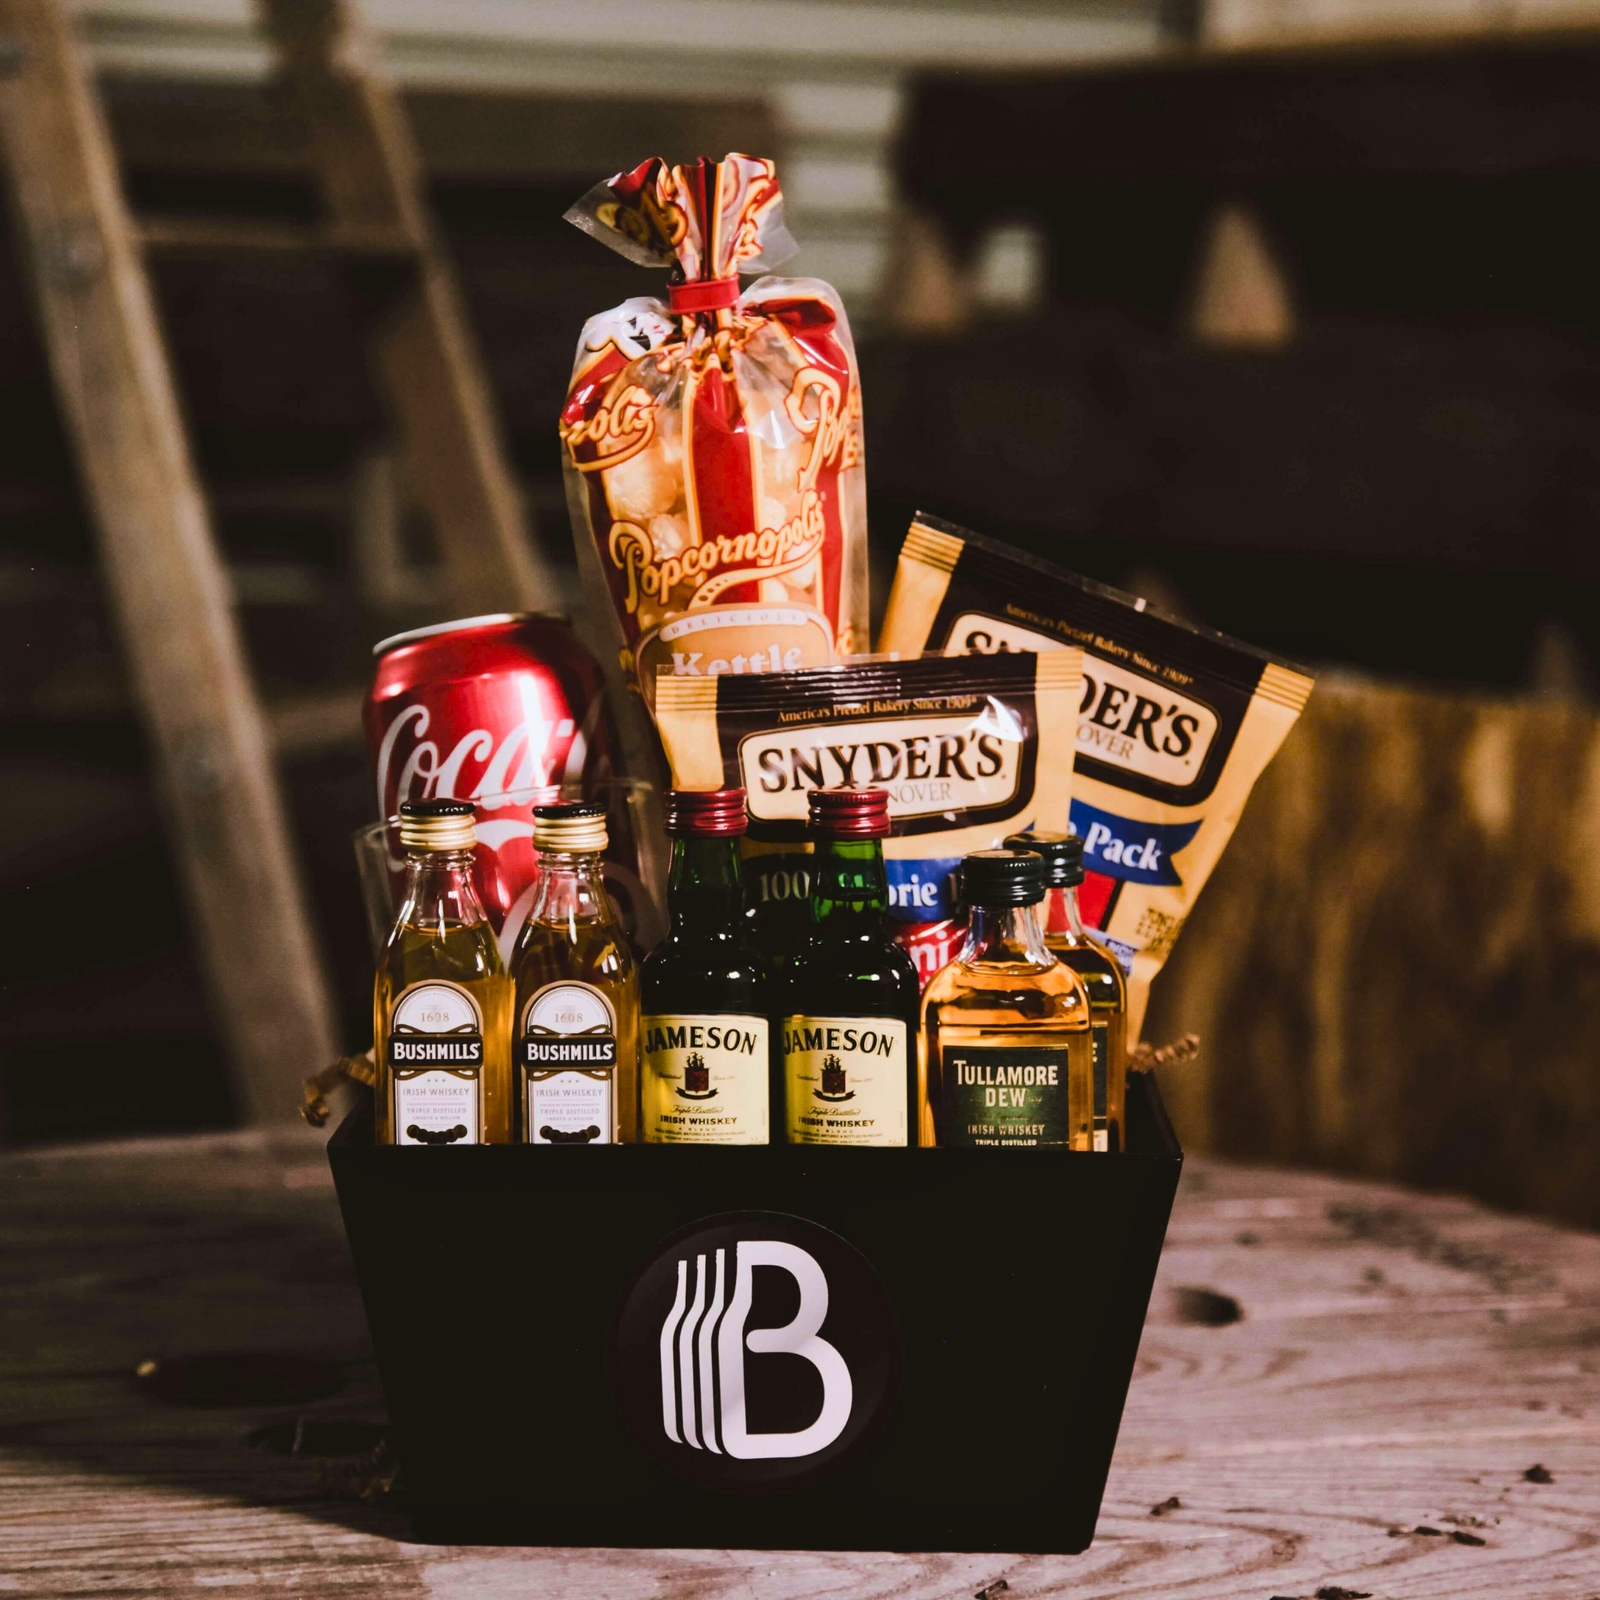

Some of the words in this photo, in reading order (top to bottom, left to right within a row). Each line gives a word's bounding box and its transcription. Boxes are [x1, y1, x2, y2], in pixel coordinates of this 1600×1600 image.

[608, 488, 825, 614] Popcornopolis
[671, 613, 799, 636] DELICIOUS
[777, 706, 831, 723] America's
[833, 702, 871, 717] Pretzel
[872, 698, 910, 715] Bakery
[912, 698, 943, 711] Since
[757, 730, 1004, 794] SNYDER'S
[1083, 821, 1163, 872] Pack
[760, 870, 810, 902] 100
[555, 1012, 584, 1024] 1608
[393, 1042, 480, 1060] BUSHMILLS
[527, 1043, 614, 1061] BUSHMILLS
[645, 1026, 758, 1056] JAMESON
[783, 1027, 894, 1058] JAMESON
[953, 1060, 1059, 1086] TULLAMORE
[403, 1088, 427, 1096] IRISH
[429, 1088, 470, 1096] WHISKEY
[536, 1089, 560, 1097] IRISH
[563, 1089, 603, 1097] WHISKEY
[985, 1087, 1027, 1108] DEW
[660, 1115, 686, 1125] IRISH
[689, 1117, 738, 1126] WHISKEY
[798, 1116, 824, 1127] IRISH
[826, 1119, 875, 1127] WHISKEY
[967, 1124, 995, 1135] IRISH
[999, 1124, 1045, 1136] WHISKEY
